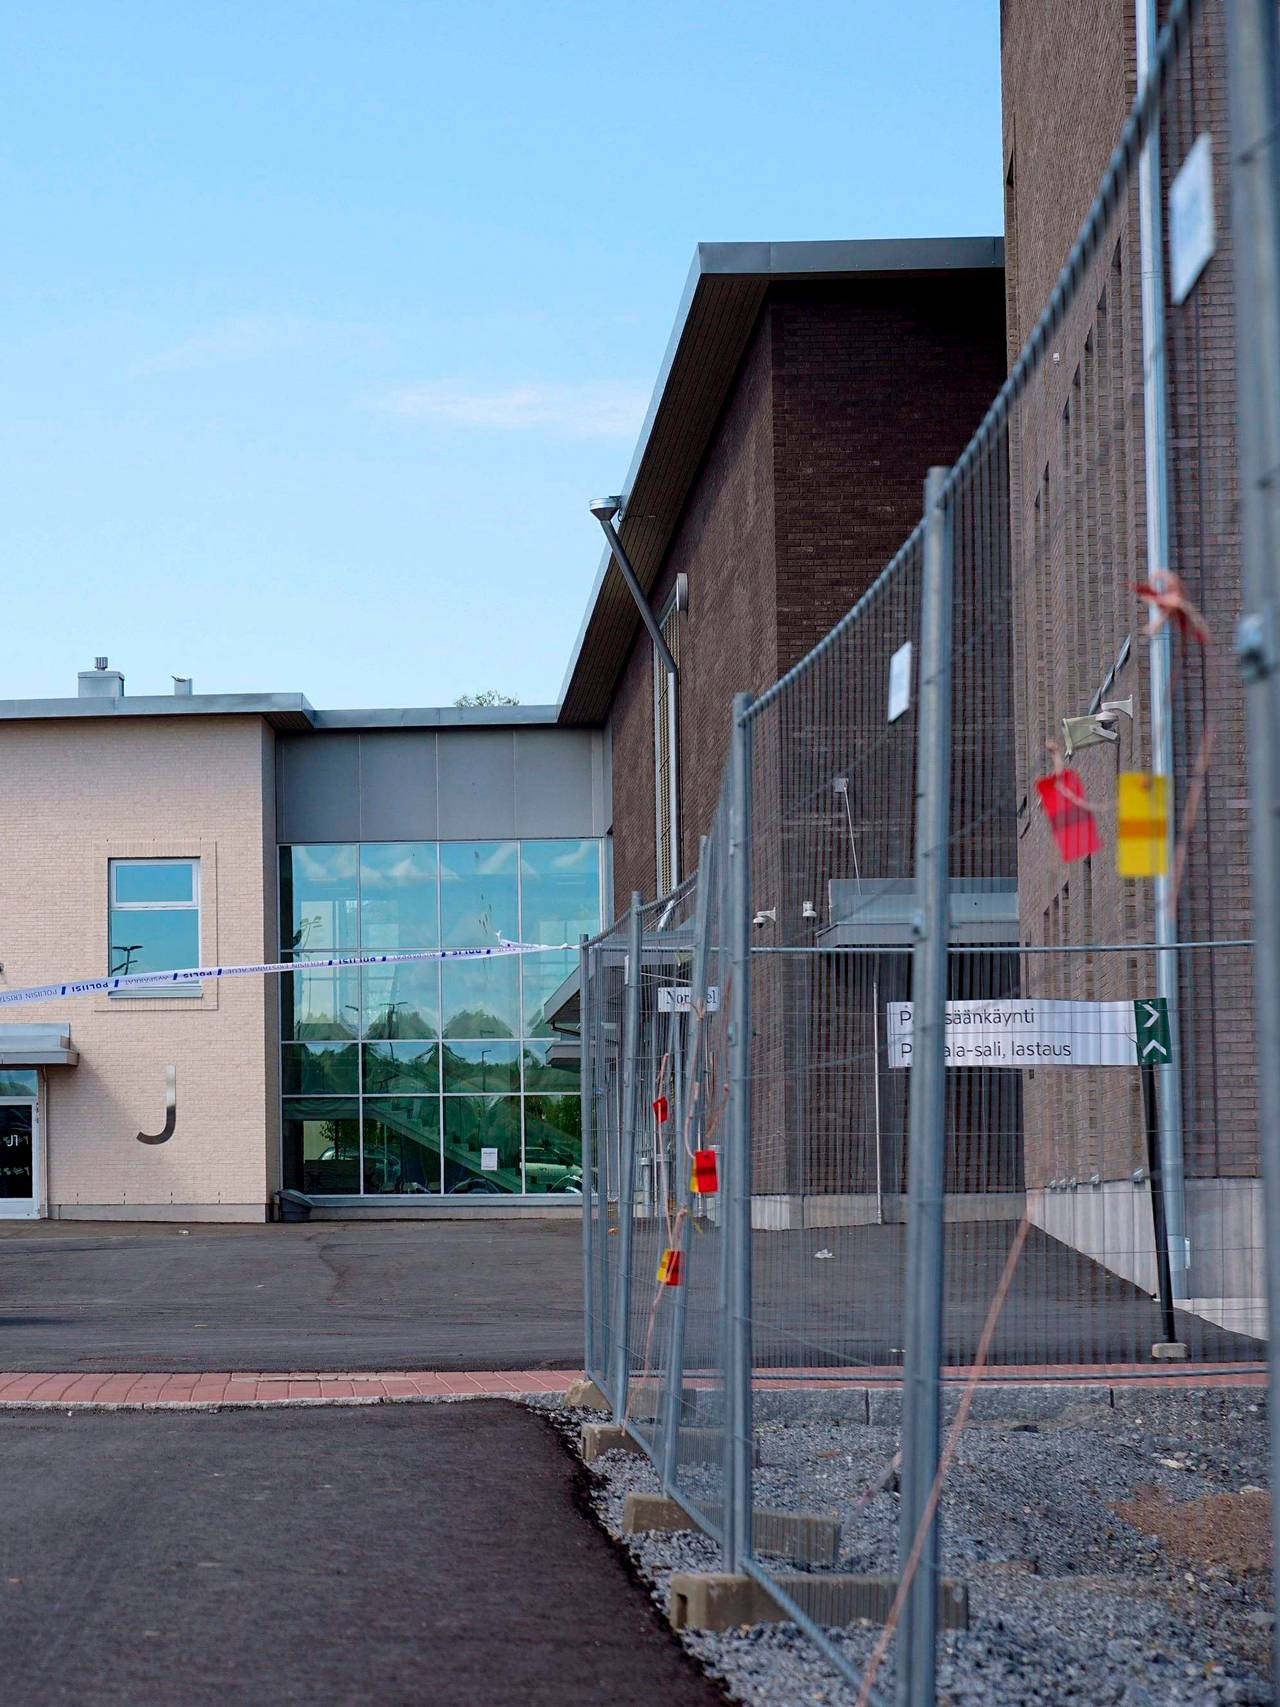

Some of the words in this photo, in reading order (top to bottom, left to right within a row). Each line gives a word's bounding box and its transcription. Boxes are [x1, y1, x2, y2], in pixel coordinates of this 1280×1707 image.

[182, 970, 212, 979] POLIS
[71, 982, 108, 993] POLIISI
[666, 990, 717, 1004] Norel
[1011, 1041, 1072, 1057] lastaus
[136, 1064, 177, 1146] J
[7, 1134, 19, 1147] J1
